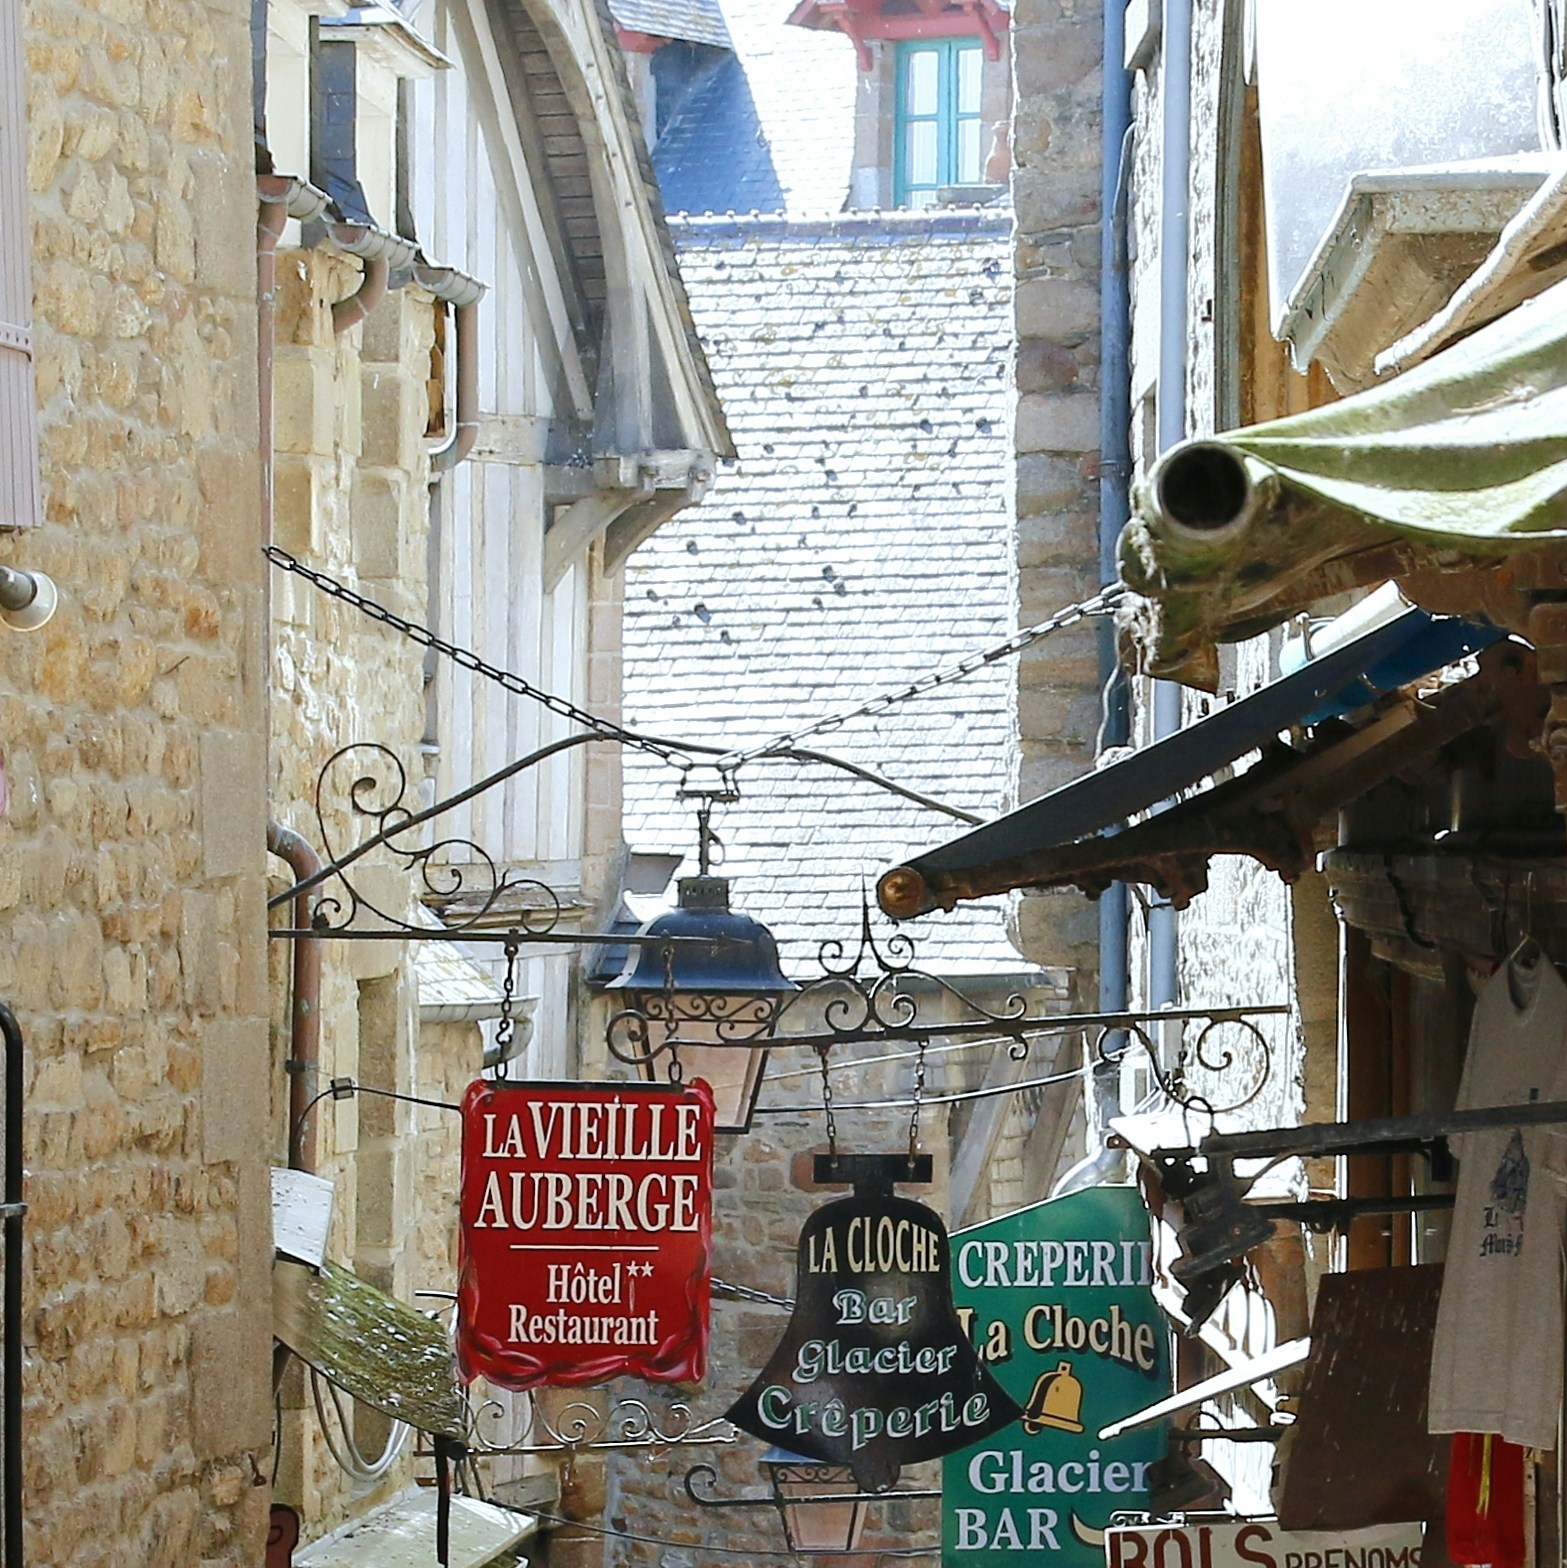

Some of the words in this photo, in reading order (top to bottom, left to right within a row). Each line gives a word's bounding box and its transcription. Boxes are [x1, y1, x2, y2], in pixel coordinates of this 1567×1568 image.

[482, 1113, 526, 1158] LA
[527, 1101, 701, 1161] VIEILLE
[473, 1170, 699, 1232] AUBERGE
[808, 1226, 838, 1273] LA
[846, 1216, 940, 1273] CLOCHE
[546, 1262, 621, 1304] Hôtel
[507, 1304, 659, 1346] Restaurant
[832, 1289, 918, 1325] Bar
[1024, 1305, 1155, 1371] Cloche
[791, 1340, 958, 1383] Glacier
[757, 1385, 990, 1451] Crêperie
[968, 1450, 1152, 1493] Glacier
[955, 1508, 1061, 1551] BAR
